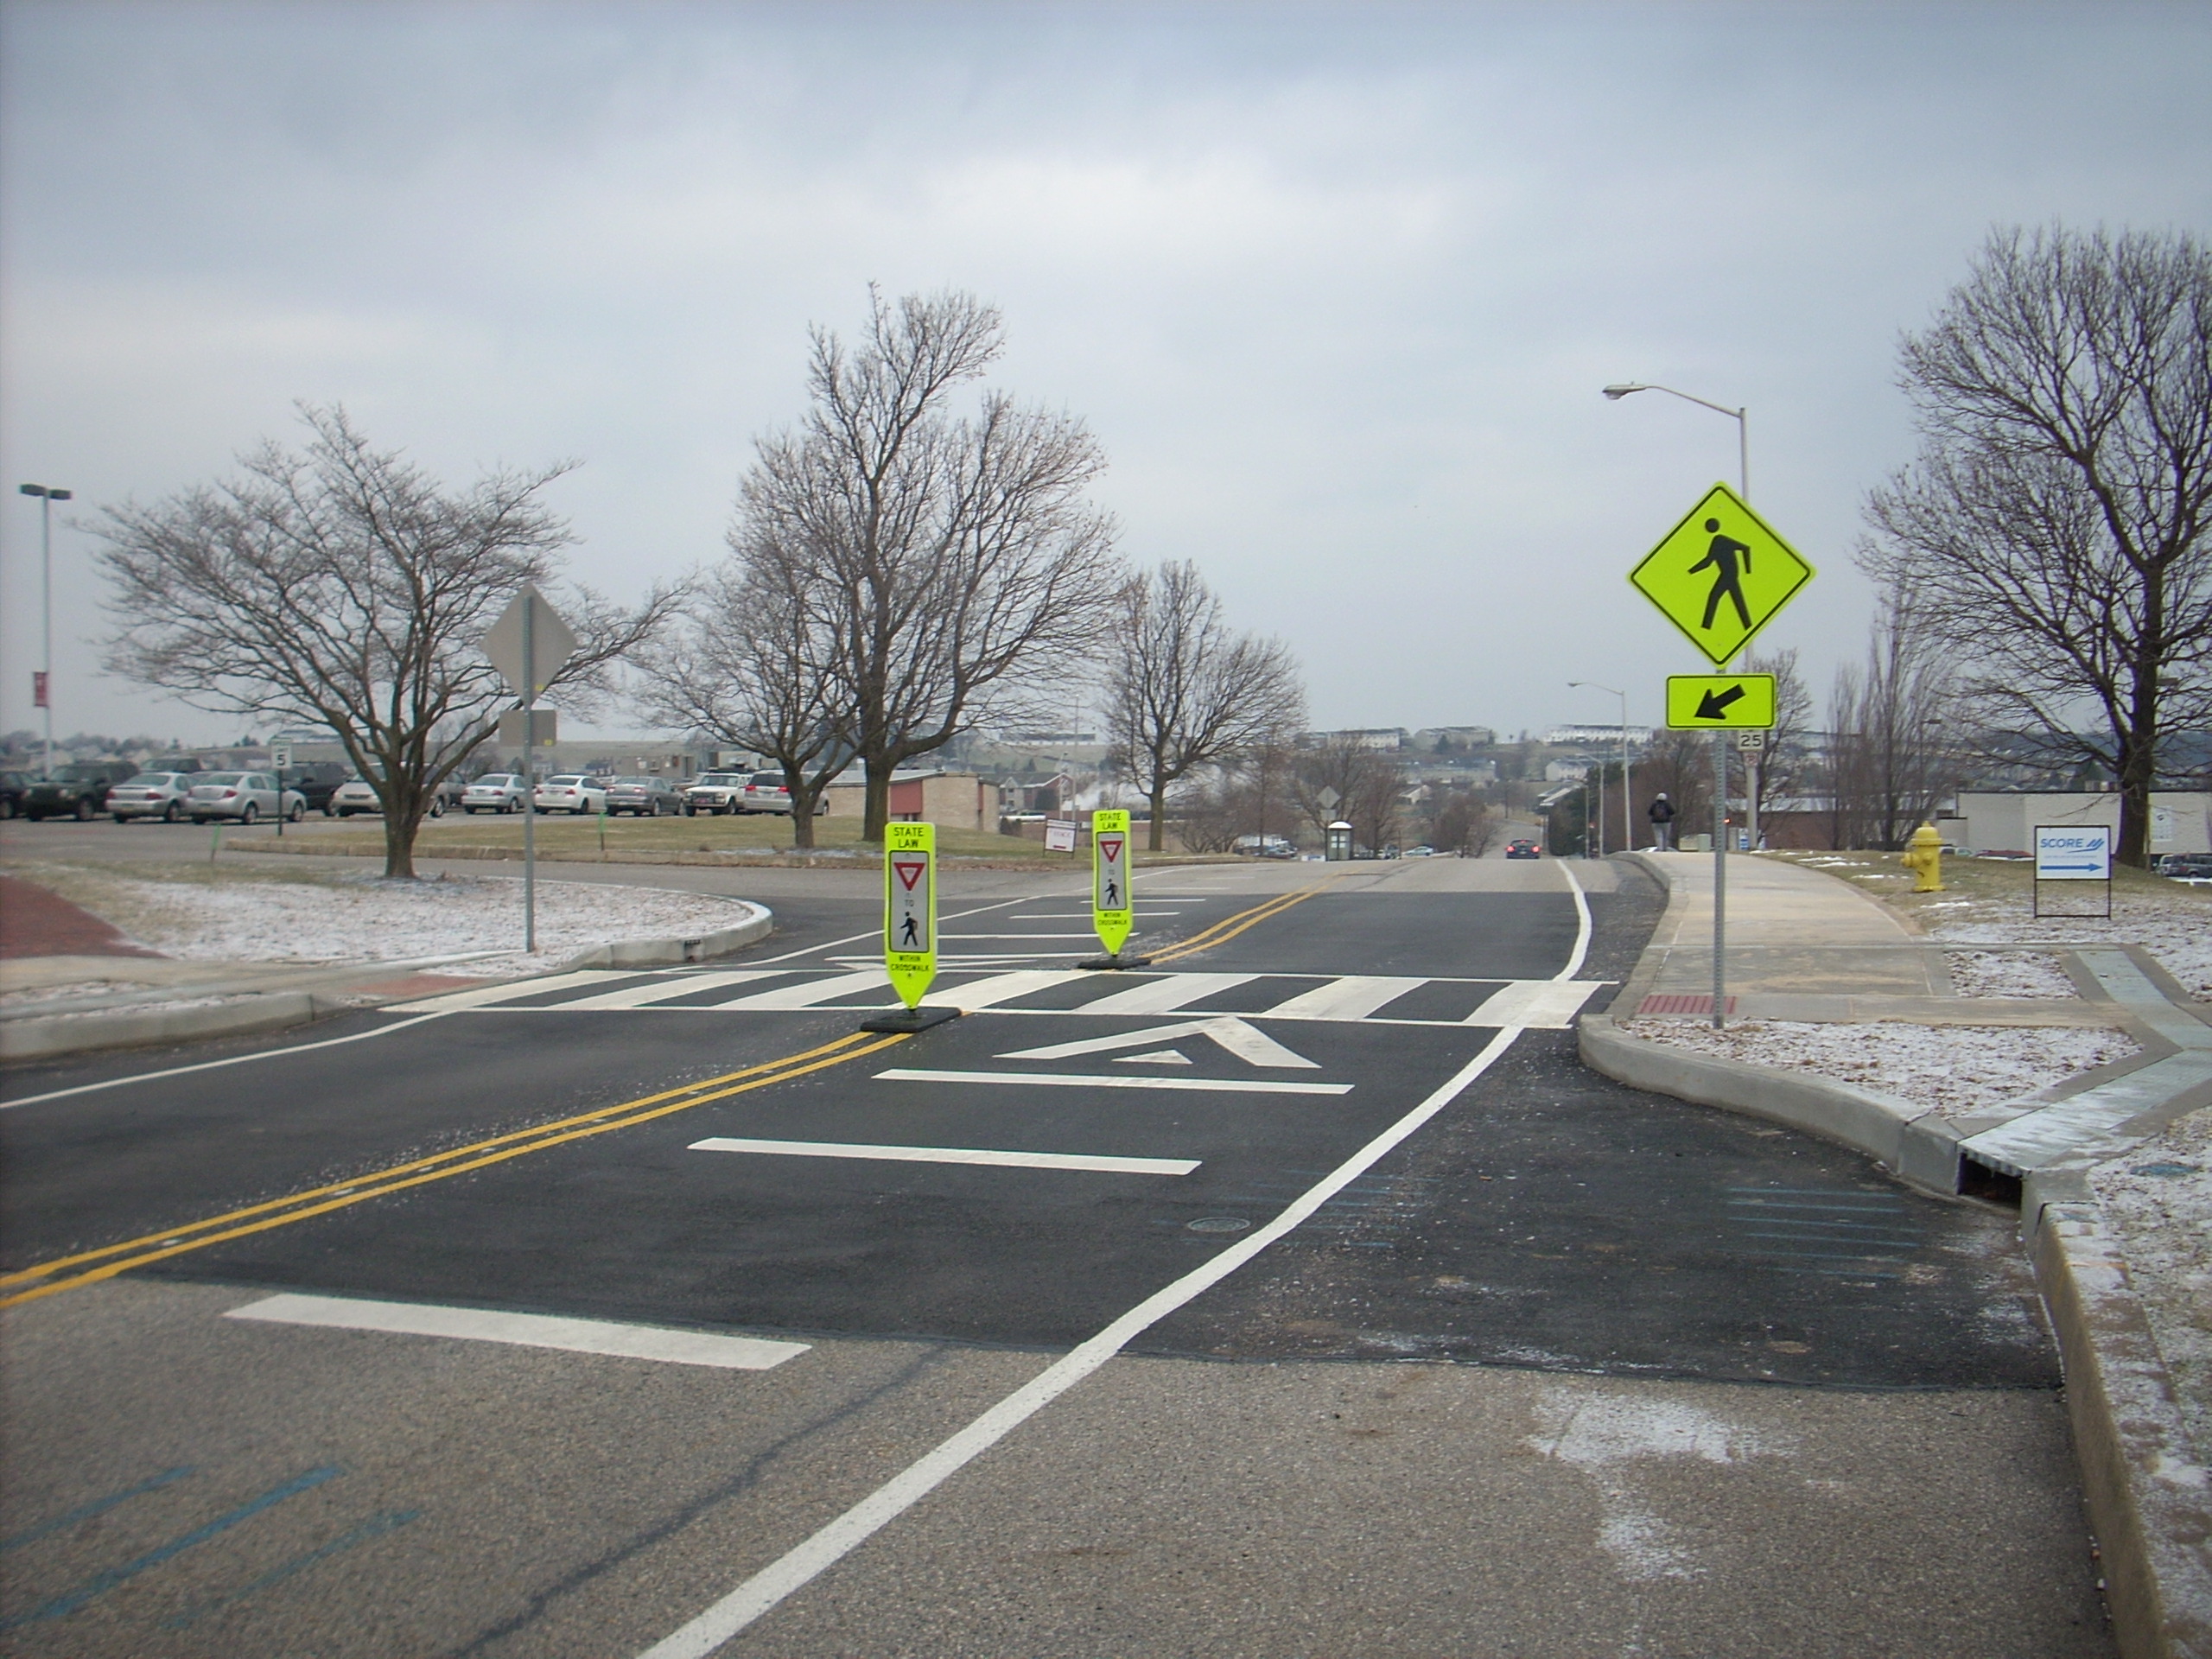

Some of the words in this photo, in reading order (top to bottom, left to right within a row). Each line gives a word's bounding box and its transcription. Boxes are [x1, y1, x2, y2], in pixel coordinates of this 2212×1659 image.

[1740, 734, 1762, 747] 25
[276, 753, 286, 766] 5
[1099, 813, 1122, 822] STATE
[893, 827, 925, 837] STATE
[898, 839, 918, 849] LAW
[2040, 838, 2084, 848] SCORE
